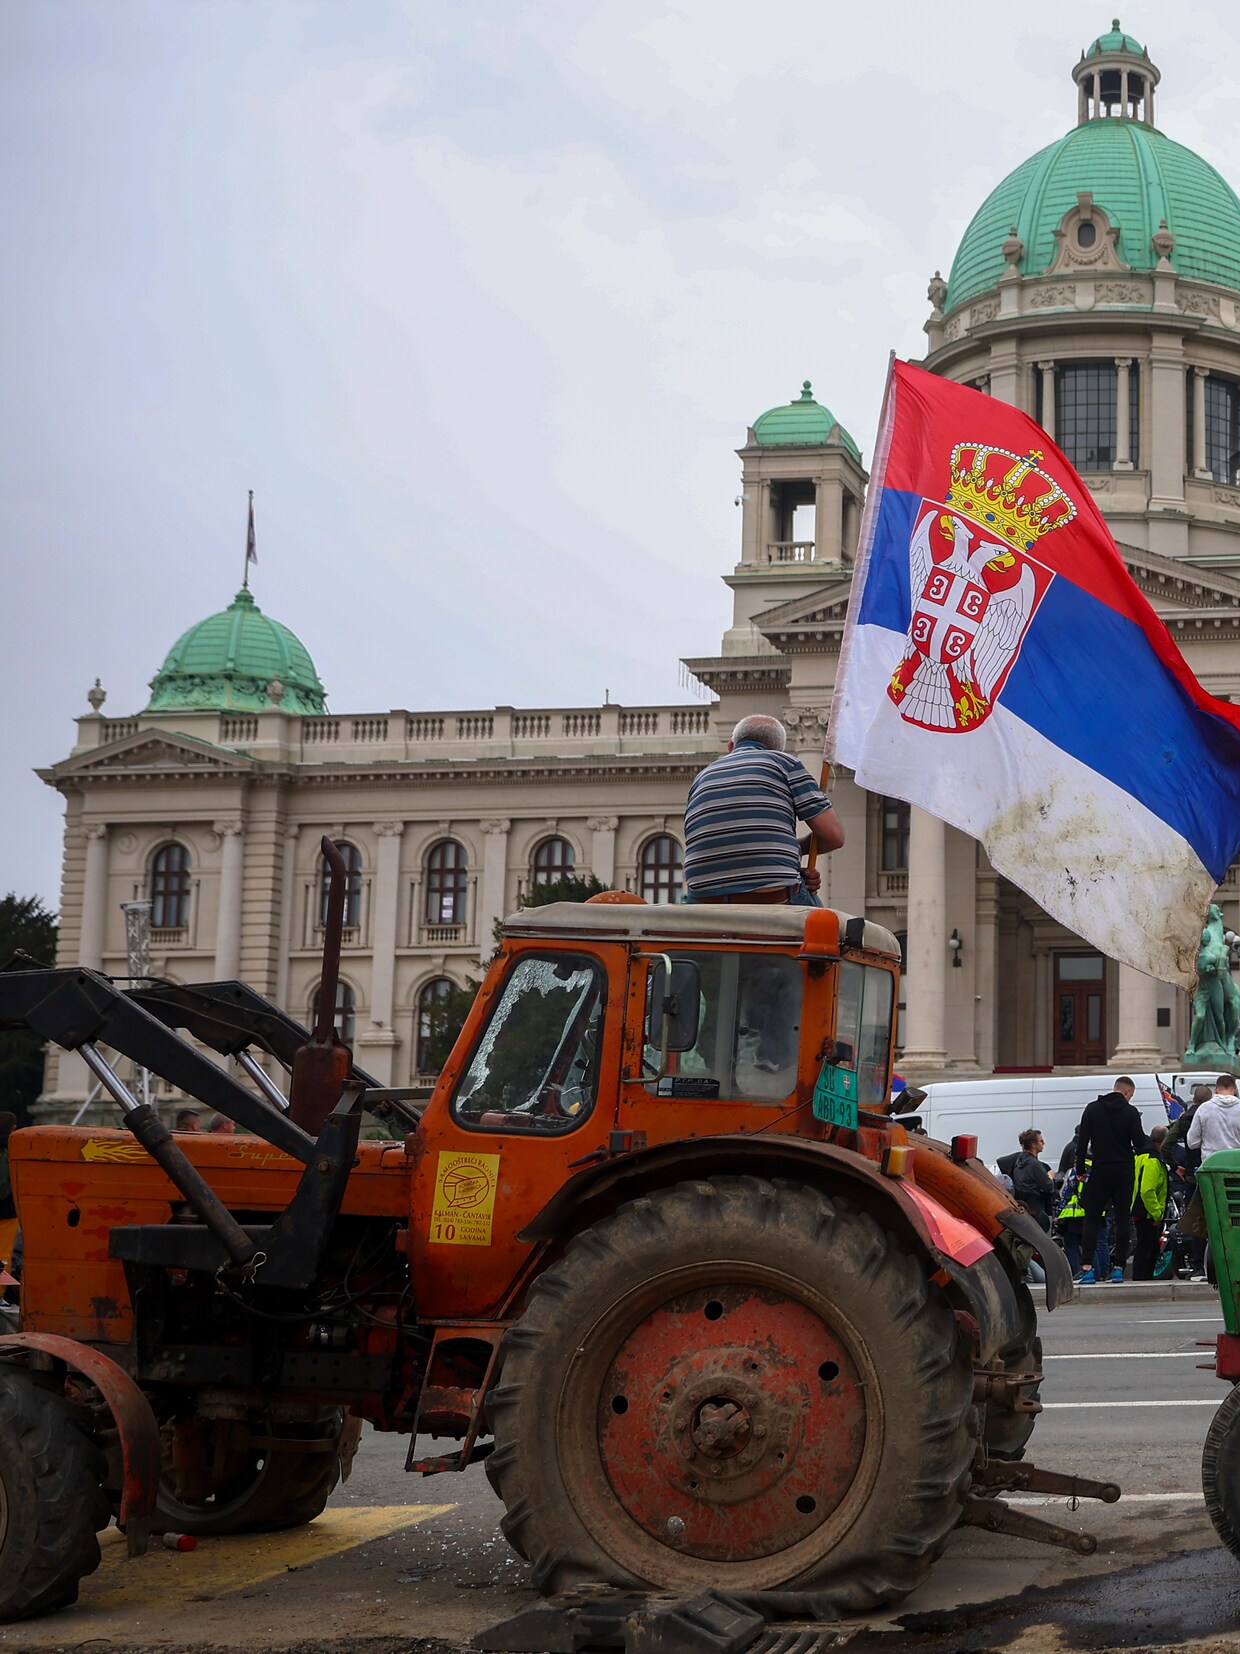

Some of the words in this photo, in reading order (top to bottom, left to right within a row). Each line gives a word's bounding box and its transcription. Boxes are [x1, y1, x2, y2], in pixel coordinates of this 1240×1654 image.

[823, 1066, 835, 1092] SU
[228, 1145, 296, 1166] Supe
[434, 1209, 459, 1217] KALMAN
[462, 1210, 491, 1220] ČANTAVIR
[435, 1223, 456, 1241] 10
[460, 1226, 486, 1234] GODINA
